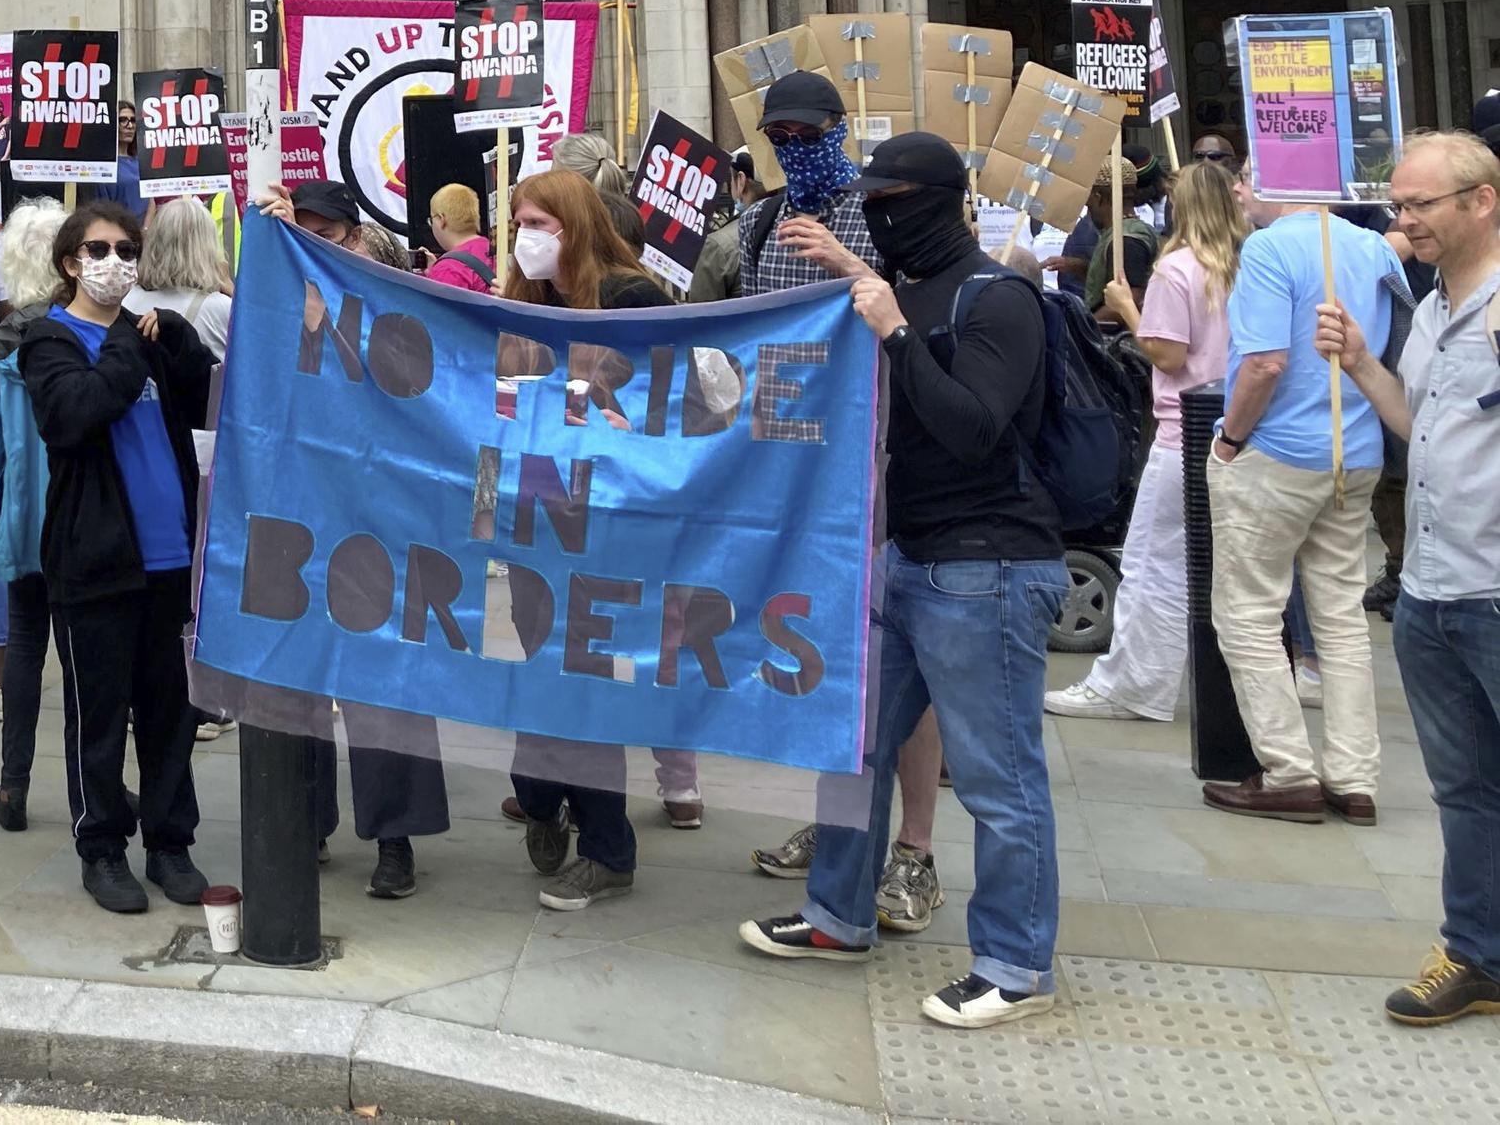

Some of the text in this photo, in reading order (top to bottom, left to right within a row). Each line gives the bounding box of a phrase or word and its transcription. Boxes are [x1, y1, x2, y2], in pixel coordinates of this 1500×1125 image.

[375, 24, 422, 55] UP
[460, 20, 538, 59] STOP
[460, 54, 538, 81] RWANDA
[1076, 43, 1147, 67] REFUGEES
[1254, 53, 1308, 65] HOSTILE
[20, 61, 111, 100] STOP
[1076, 66, 1146, 91] WELCOME
[1255, 66, 1332, 77] ENVIRONMENT
[142, 93, 220, 129] STOP
[1255, 92, 1285, 104] ALL
[20, 101, 110, 124] RWANDA
[1256, 109, 1327, 124] REFUGEES
[145, 125, 223, 149] RWANDA
[1258, 121, 1325, 134] WELCOME
[281, 148, 320, 163] ostile
[646, 144, 718, 210] STOP
[637, 177, 706, 237] RWANDA
[298, 280, 829, 445] NO PRIDE
[469, 445, 593, 555] IN
[239, 513, 824, 696] BORDERS
